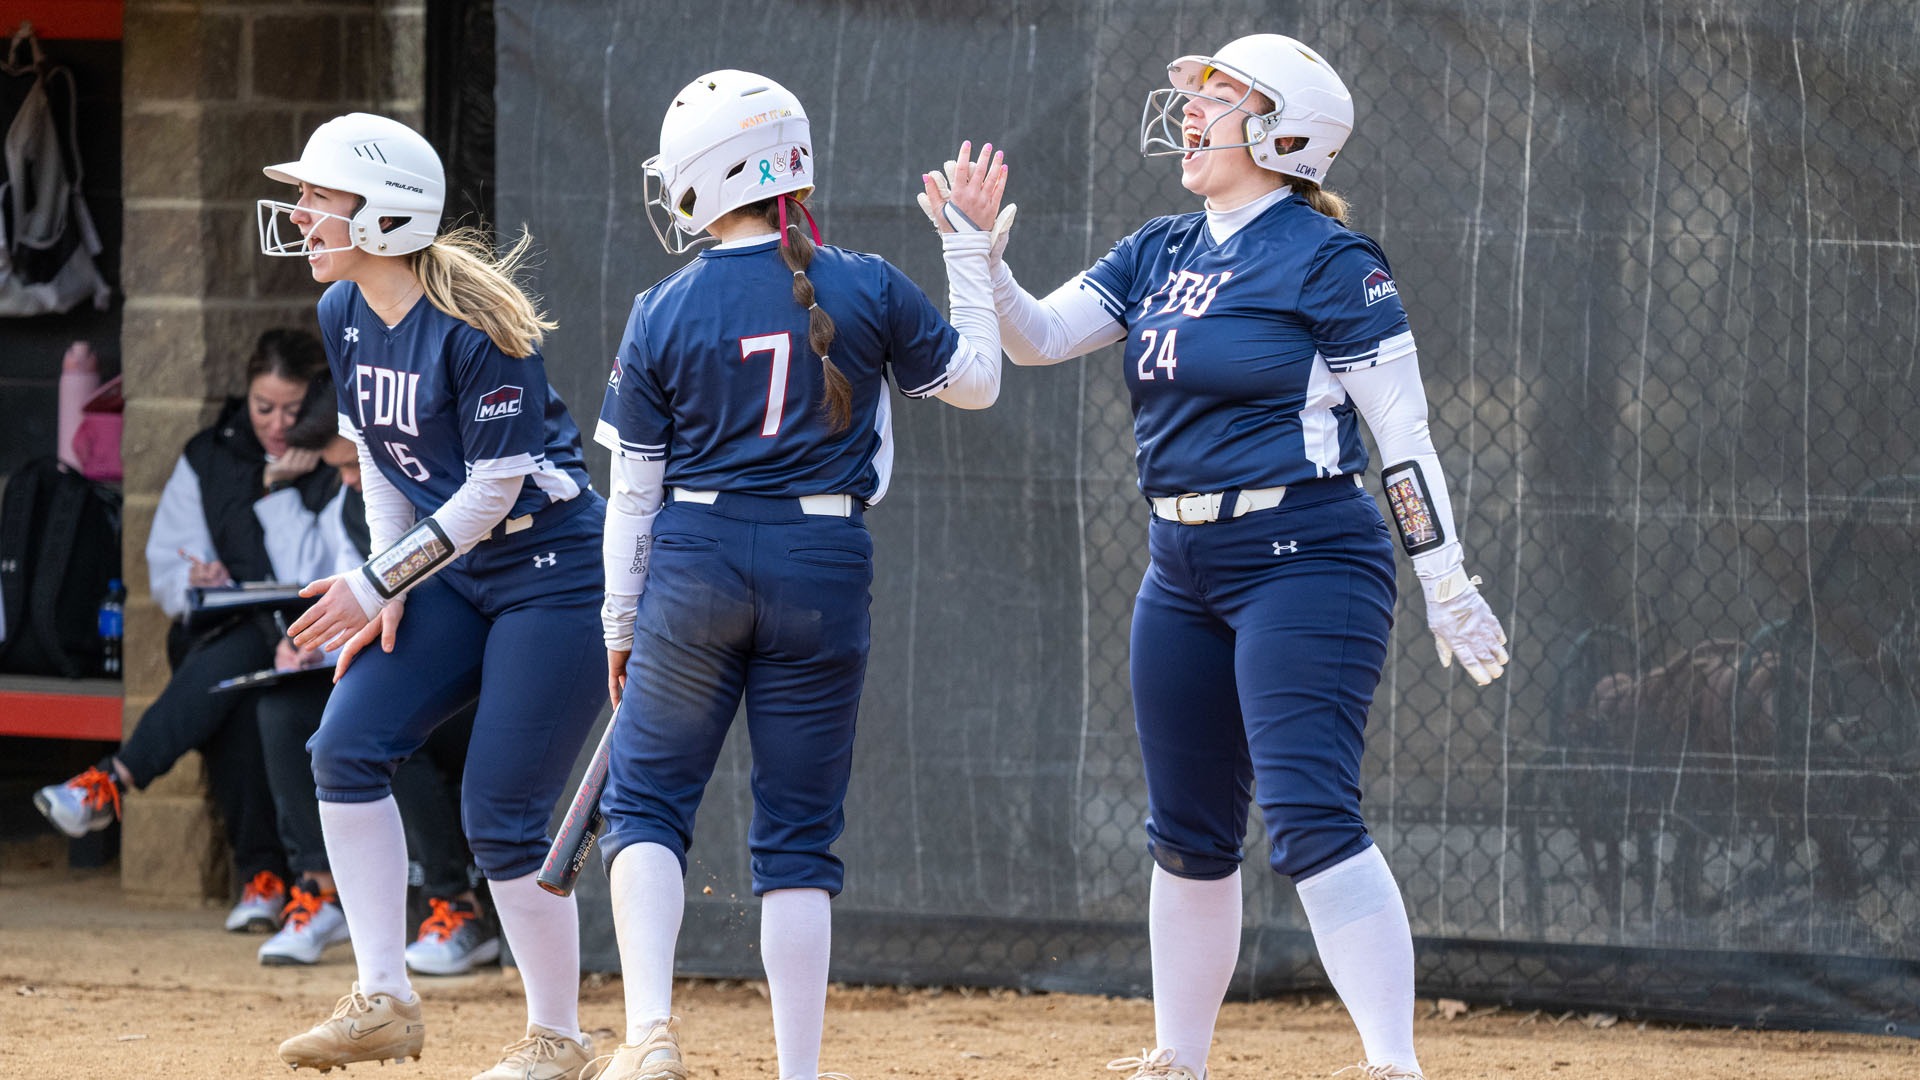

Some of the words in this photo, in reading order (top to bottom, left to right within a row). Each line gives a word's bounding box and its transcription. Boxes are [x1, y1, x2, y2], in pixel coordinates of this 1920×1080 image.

[385, 180, 424, 194] RAWLINGS
[1368, 280, 1396, 301] MAC
[1137, 328, 1178, 380] 24
[356, 364, 421, 437] FDU
[738, 330, 793, 438] 7
[480, 398, 520, 418] MAC
[384, 441, 431, 482] 15
[632, 534, 647, 567] SPORTS
[572, 830, 593, 864] BARREL
[577, 834, 596, 869] DOUBLE
